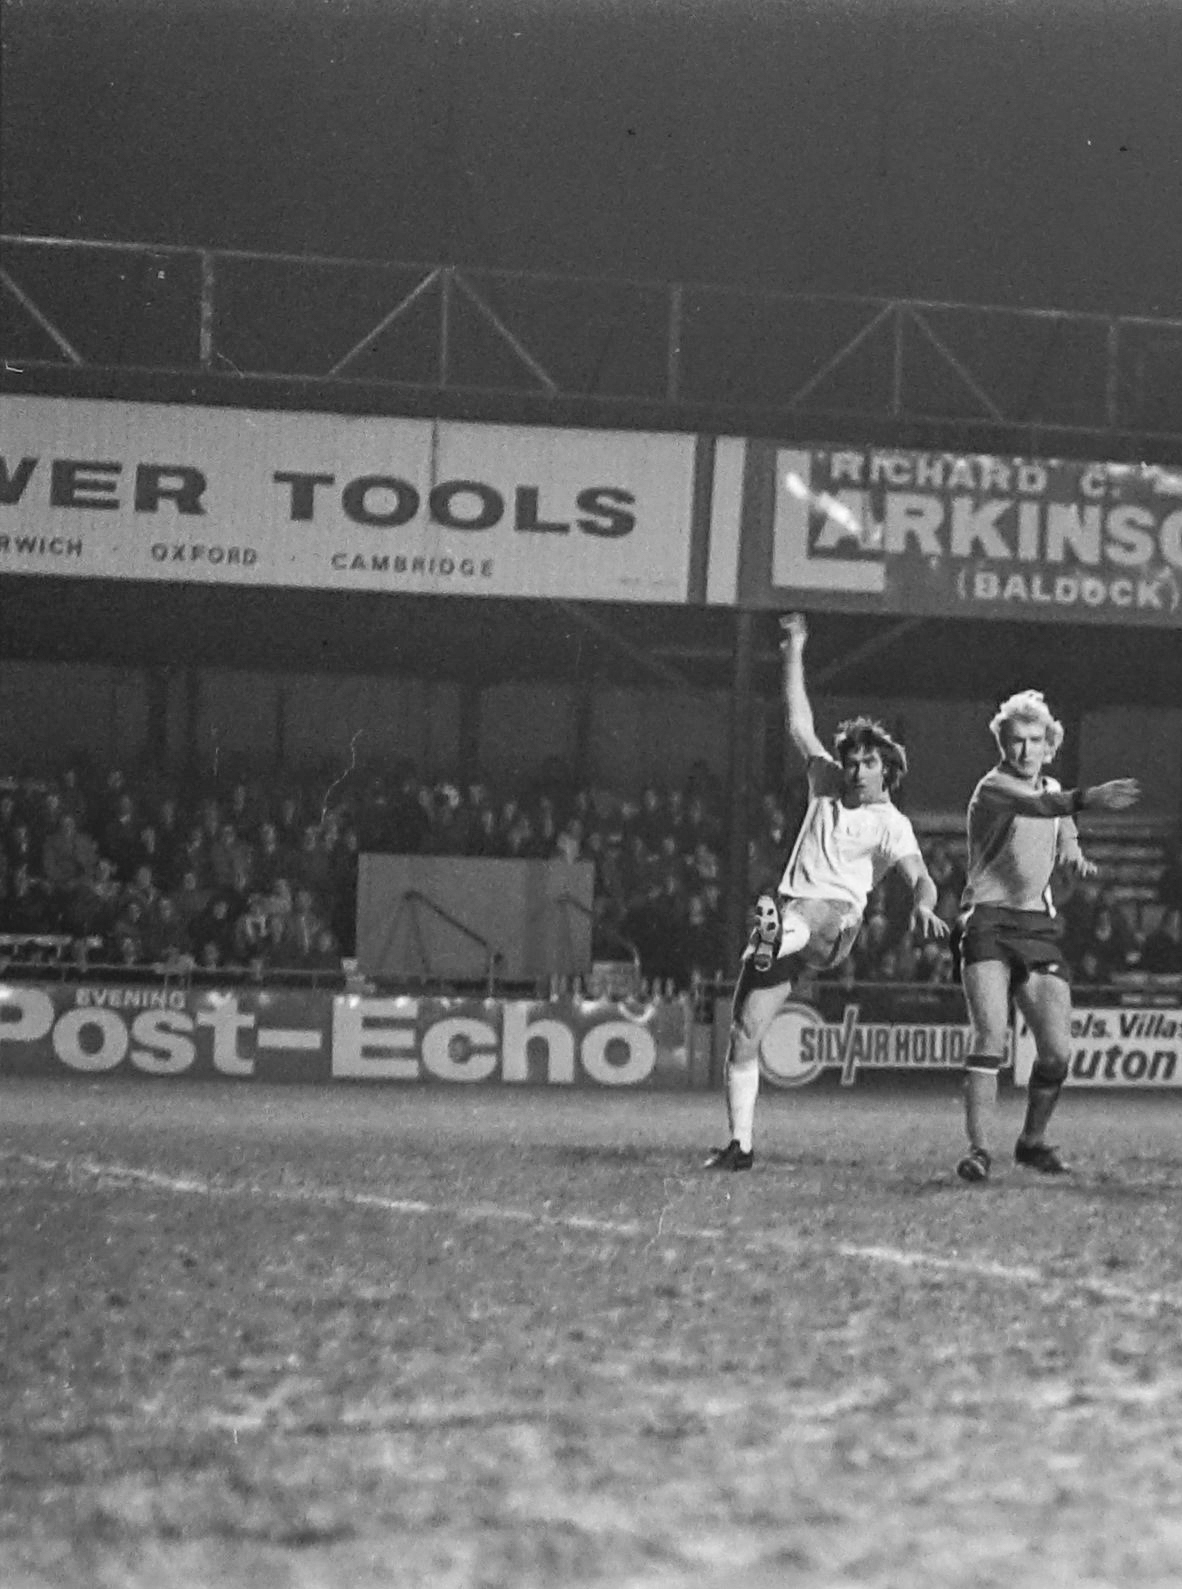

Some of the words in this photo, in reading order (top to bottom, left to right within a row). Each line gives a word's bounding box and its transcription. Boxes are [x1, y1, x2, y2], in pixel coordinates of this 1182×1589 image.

[273, 469, 637, 538] TOOLS
[151, 541, 258, 566] OXFORD
[331, 551, 495, 578] CAMBRIDGE
[957, 569, 1180, 612] (BALDOCK)
[75, 987, 186, 1009] EVENING
[1070, 1043, 1177, 1082] uton
